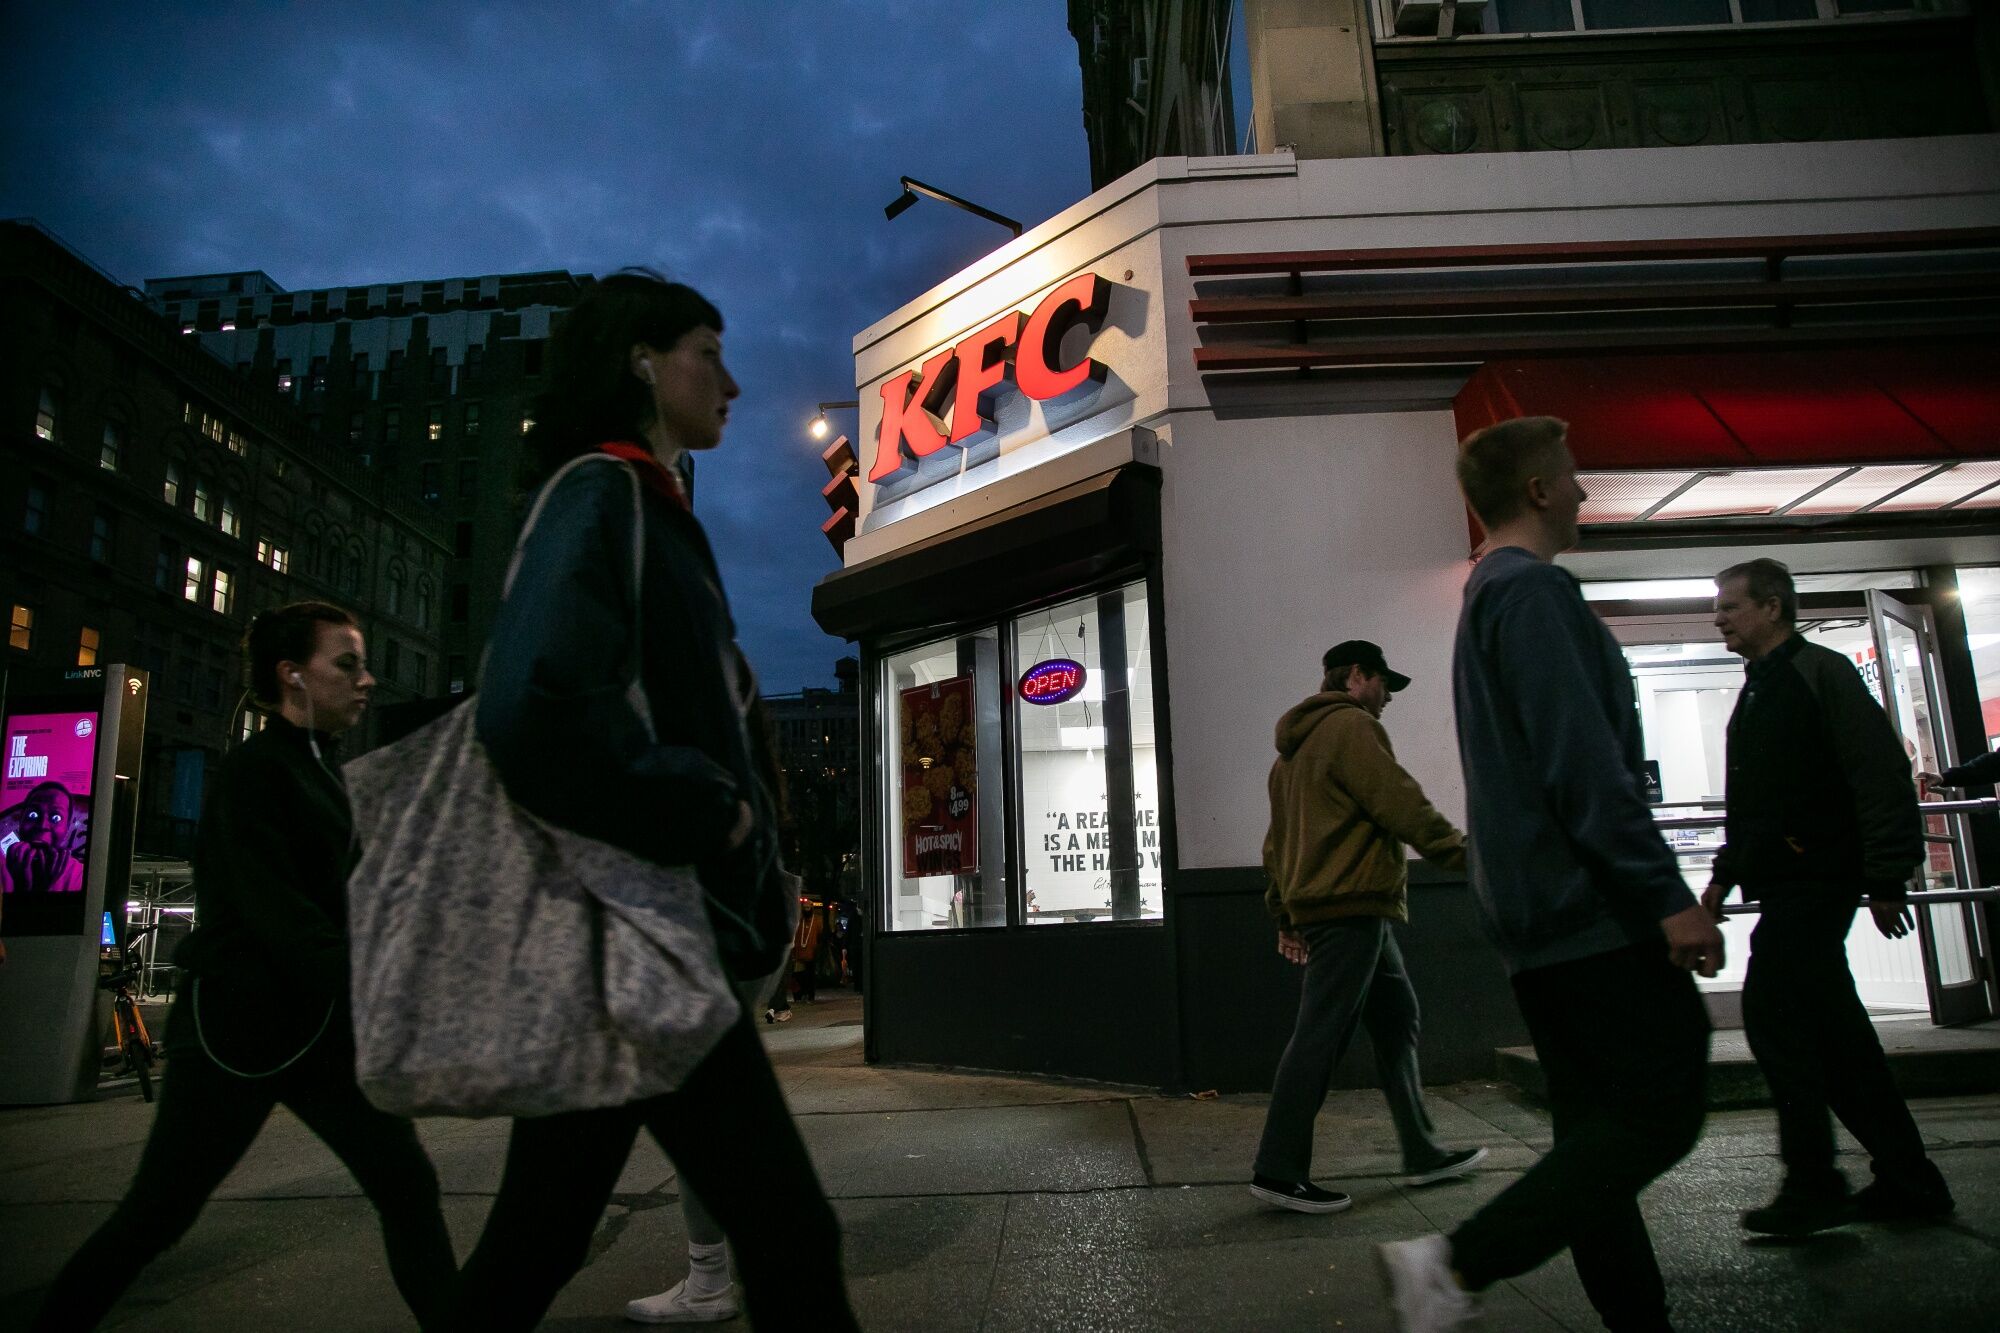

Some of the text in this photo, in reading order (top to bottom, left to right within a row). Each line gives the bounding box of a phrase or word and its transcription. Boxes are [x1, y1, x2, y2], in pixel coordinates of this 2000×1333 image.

[868, 272, 1108, 482] KFC
[65, 669, 102, 679] LinkNYC
[1024, 669, 1076, 695] OPEN
[12, 736, 28, 757] THE
[8, 756, 48, 778] EXPIRING
[1076, 812, 1108, 829] REA
[1044, 834, 1061, 851] IS
[1067, 833, 1080, 850] A
[1086, 833, 1110, 850] ME
[1050, 854, 1086, 872] THE
